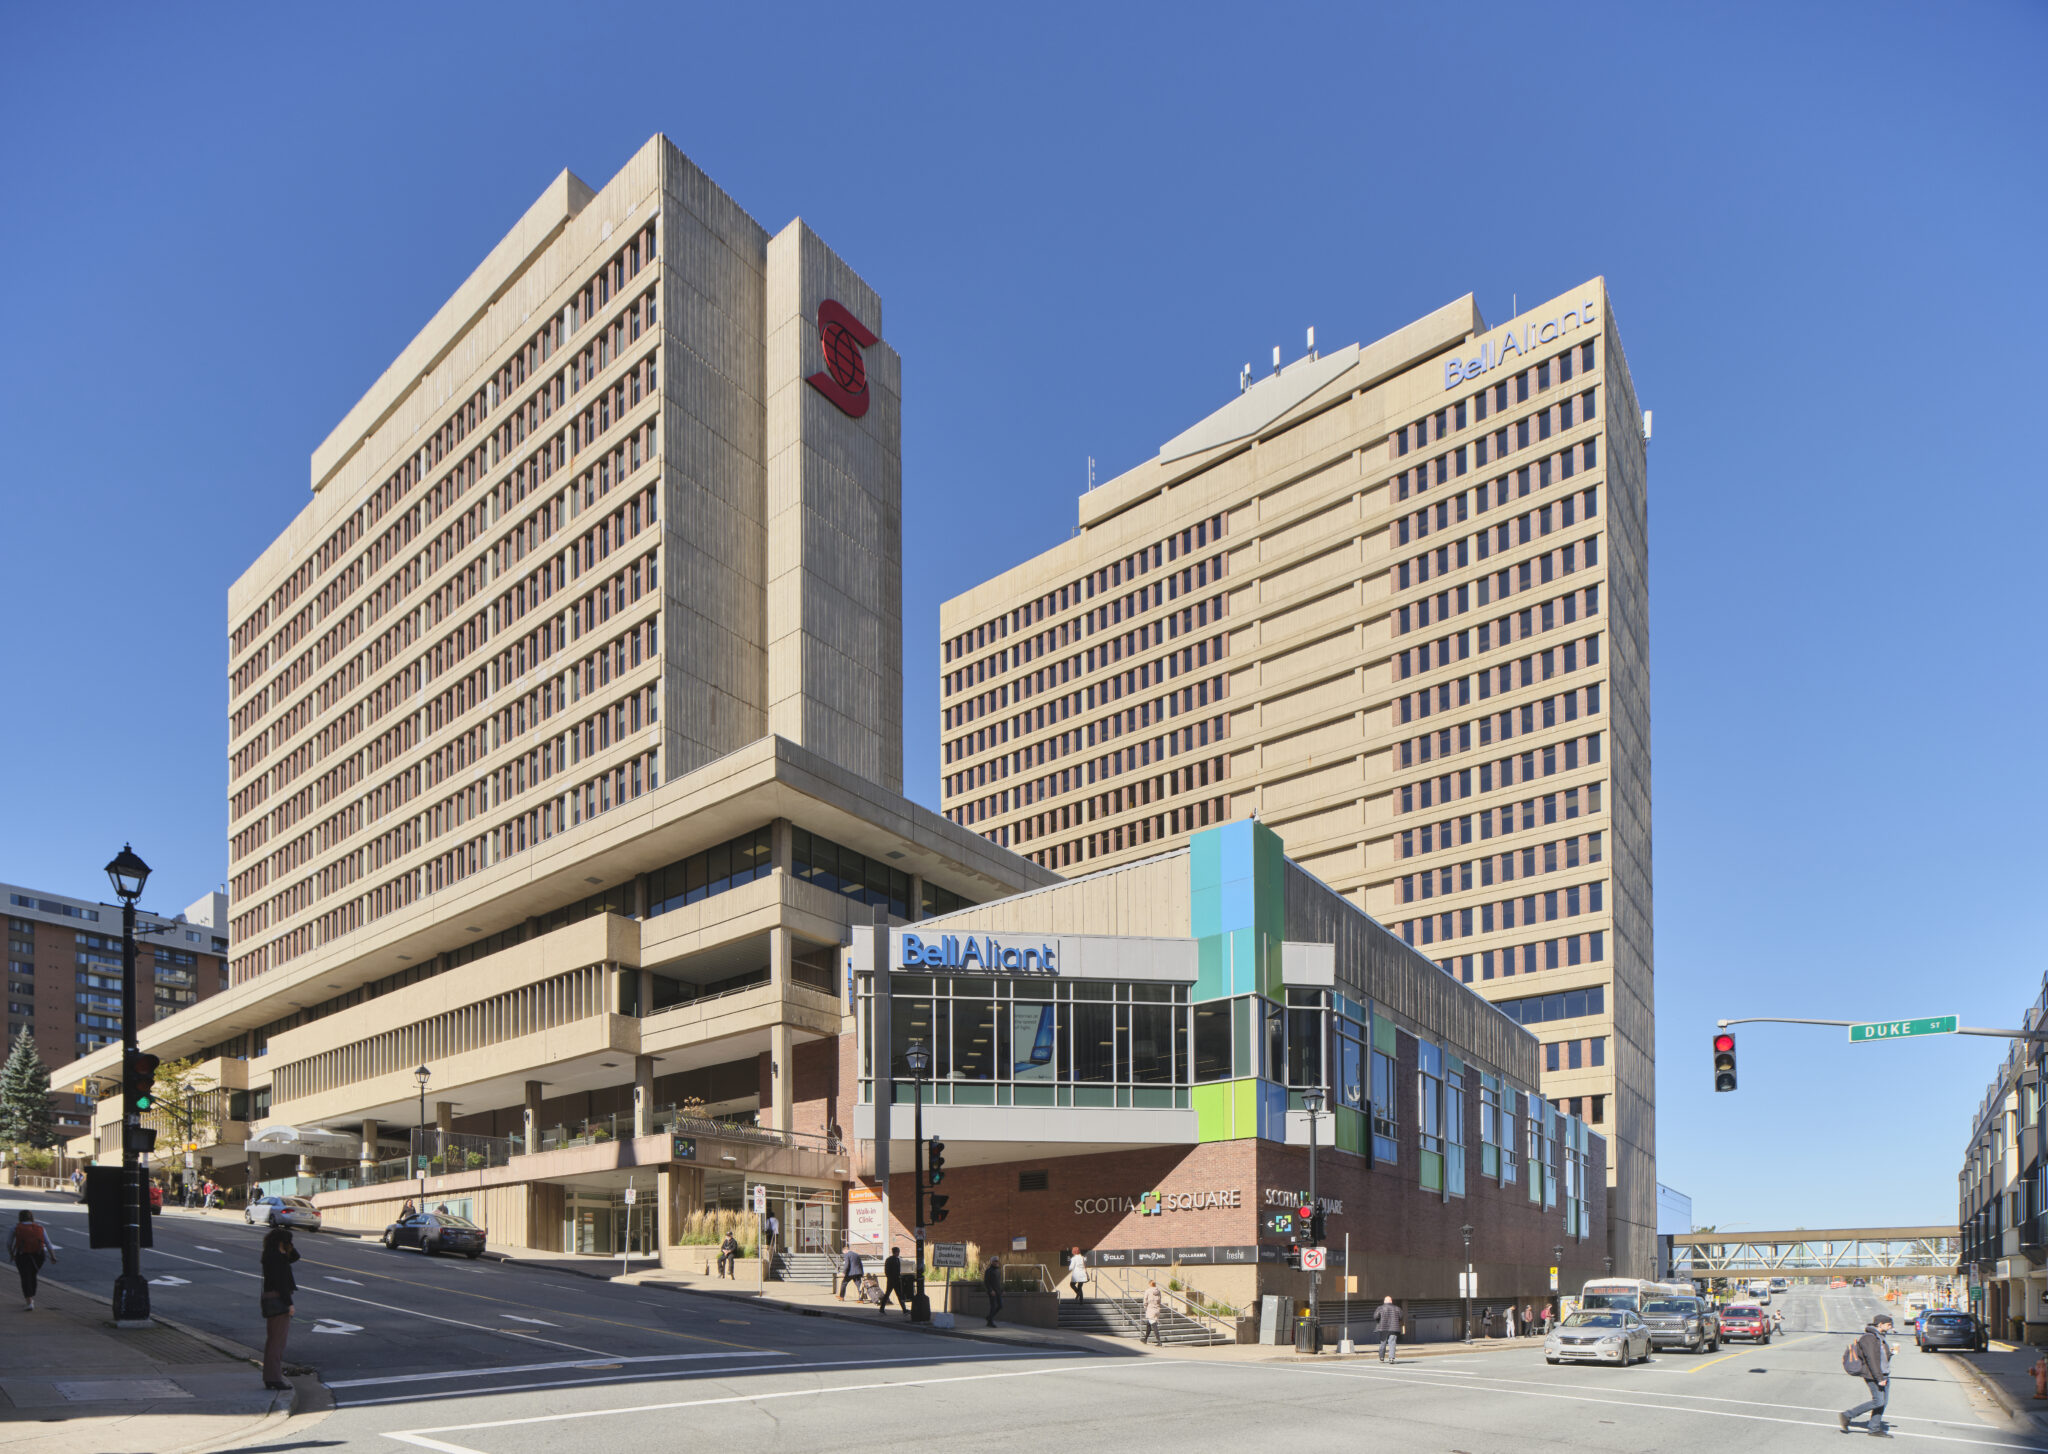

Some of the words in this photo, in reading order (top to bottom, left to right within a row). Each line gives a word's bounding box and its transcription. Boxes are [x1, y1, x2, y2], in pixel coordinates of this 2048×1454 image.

[1865, 1022, 1911, 1038] DUKE
[1930, 1021, 1941, 1029] ST
[679, 1144, 684, 1152] P
[1074, 1196, 1136, 1215] SCOTIA
[1167, 1190, 1241, 1211] SQUARE
[1265, 1188, 1300, 1209] SCOTIA
[1315, 1197, 1343, 1215] QUARE
[1280, 1219, 1287, 1228] P
